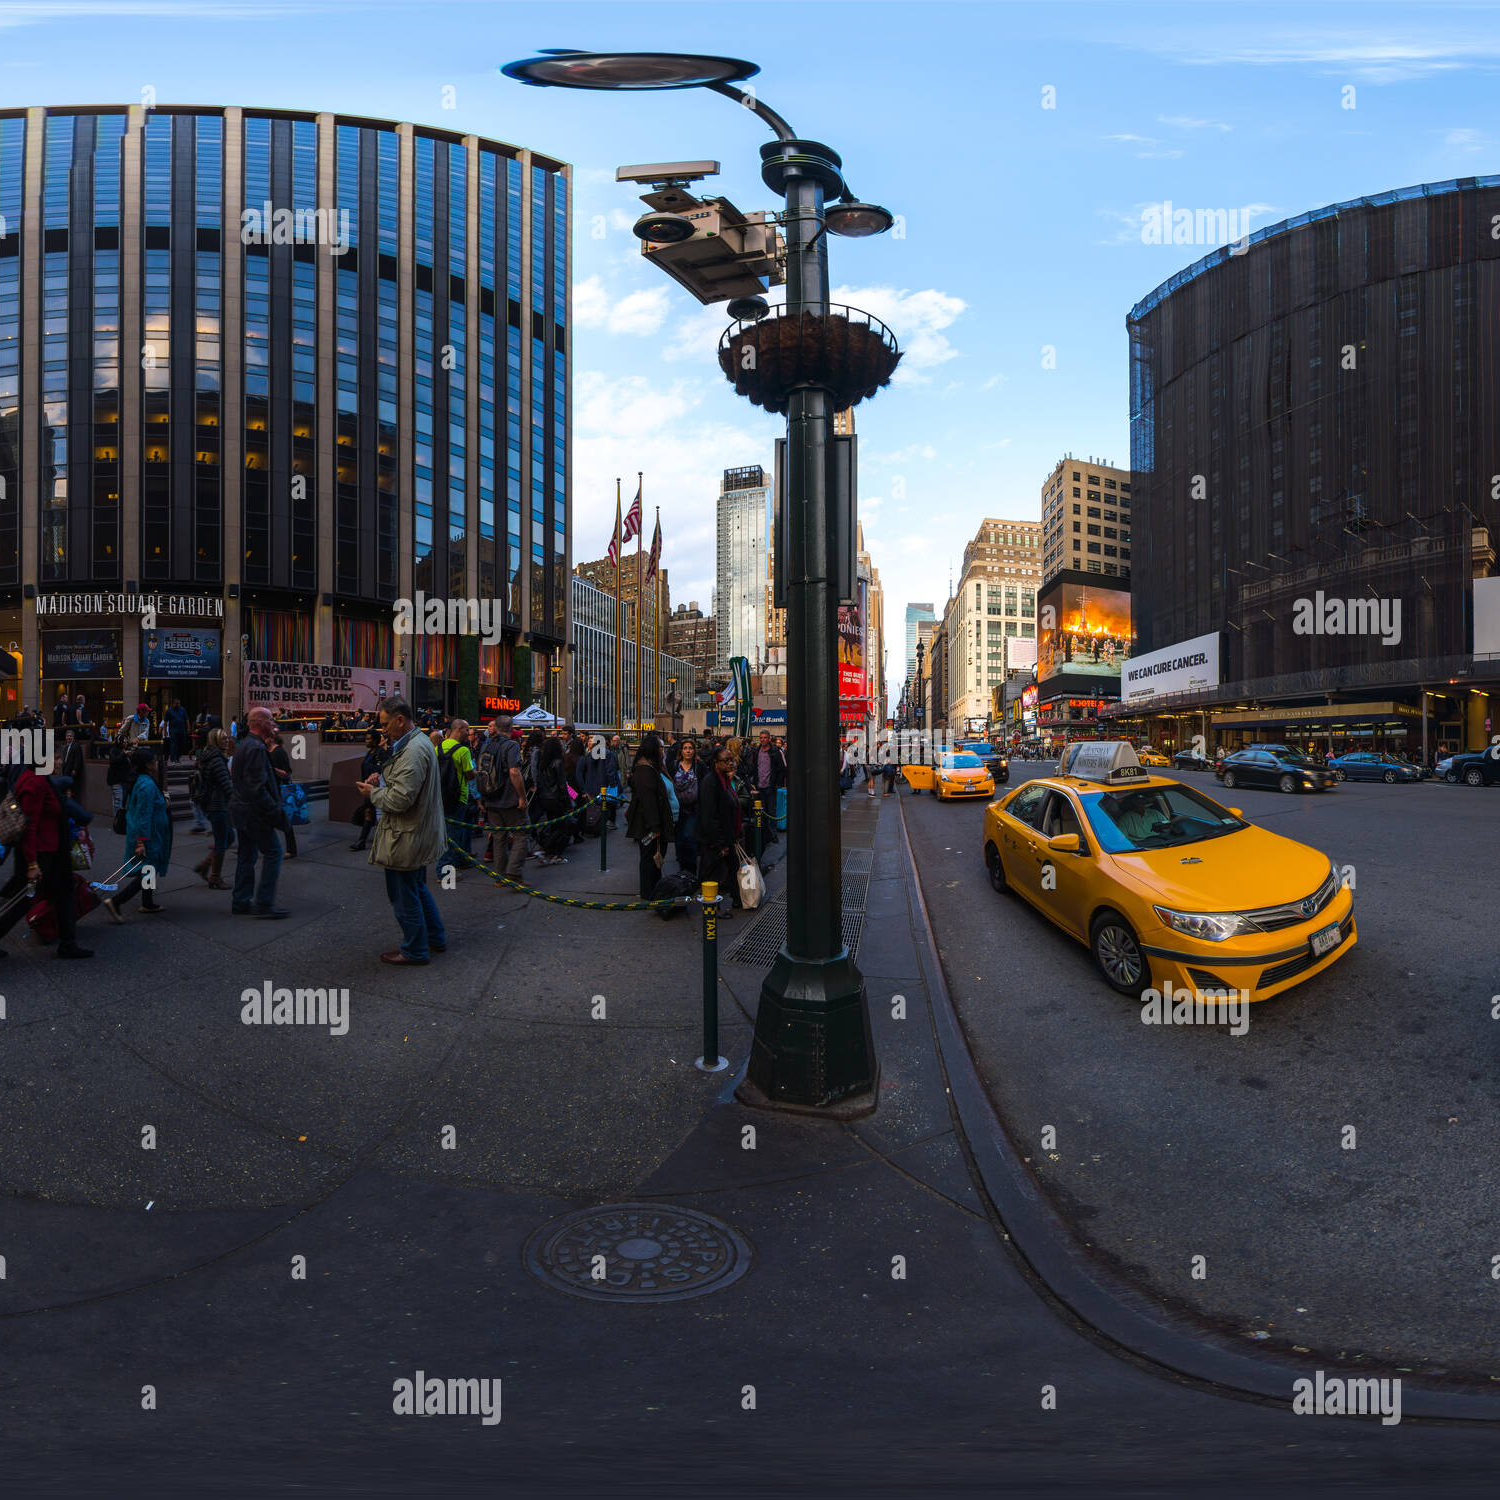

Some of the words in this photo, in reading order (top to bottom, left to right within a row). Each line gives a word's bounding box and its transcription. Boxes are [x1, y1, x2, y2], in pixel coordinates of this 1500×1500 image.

[36, 594, 102, 615] MADISON
[108, 594, 167, 614] SQUARE
[169, 595, 223, 617] GARDEN
[163, 641, 201, 650] HEROES
[249, 662, 258, 673] A
[261, 662, 299, 675] NAME
[301, 664, 319, 676] AS
[322, 665, 352, 678] BOLD
[1127, 670, 1139, 682] WE
[1139, 666, 1153, 679] CAN
[1153, 661, 1171, 675] CURE
[1172, 652, 1209, 671] CANCER.
[249, 674, 270, 688] AS
[273, 675, 303, 689] OUR
[306, 677, 351, 691] TASTE.
[248, 690, 279, 701] THAT'S
[282, 691, 315, 702] BEST
[317, 693, 352, 703] DAMN
[485, 697, 520, 711] PENNSY
[1120, 768, 1138, 777] 8K81
[706, 918, 716, 940] TAXI
